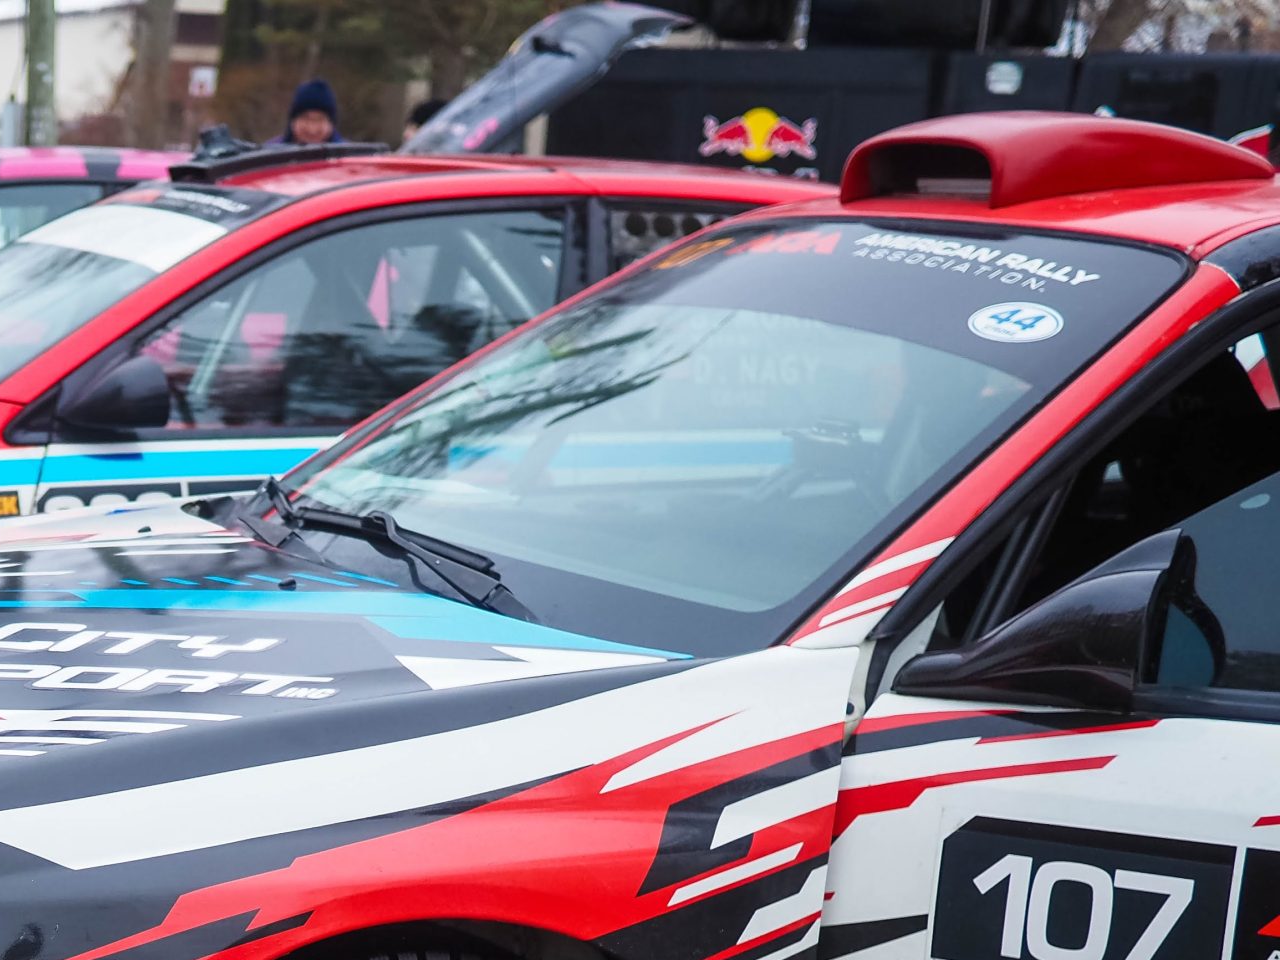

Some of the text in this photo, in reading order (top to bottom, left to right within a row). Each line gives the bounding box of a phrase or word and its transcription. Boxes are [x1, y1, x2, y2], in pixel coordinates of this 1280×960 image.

[853, 232, 1101, 287] AMERICAN RALLY
[988, 308, 1047, 331] 44
